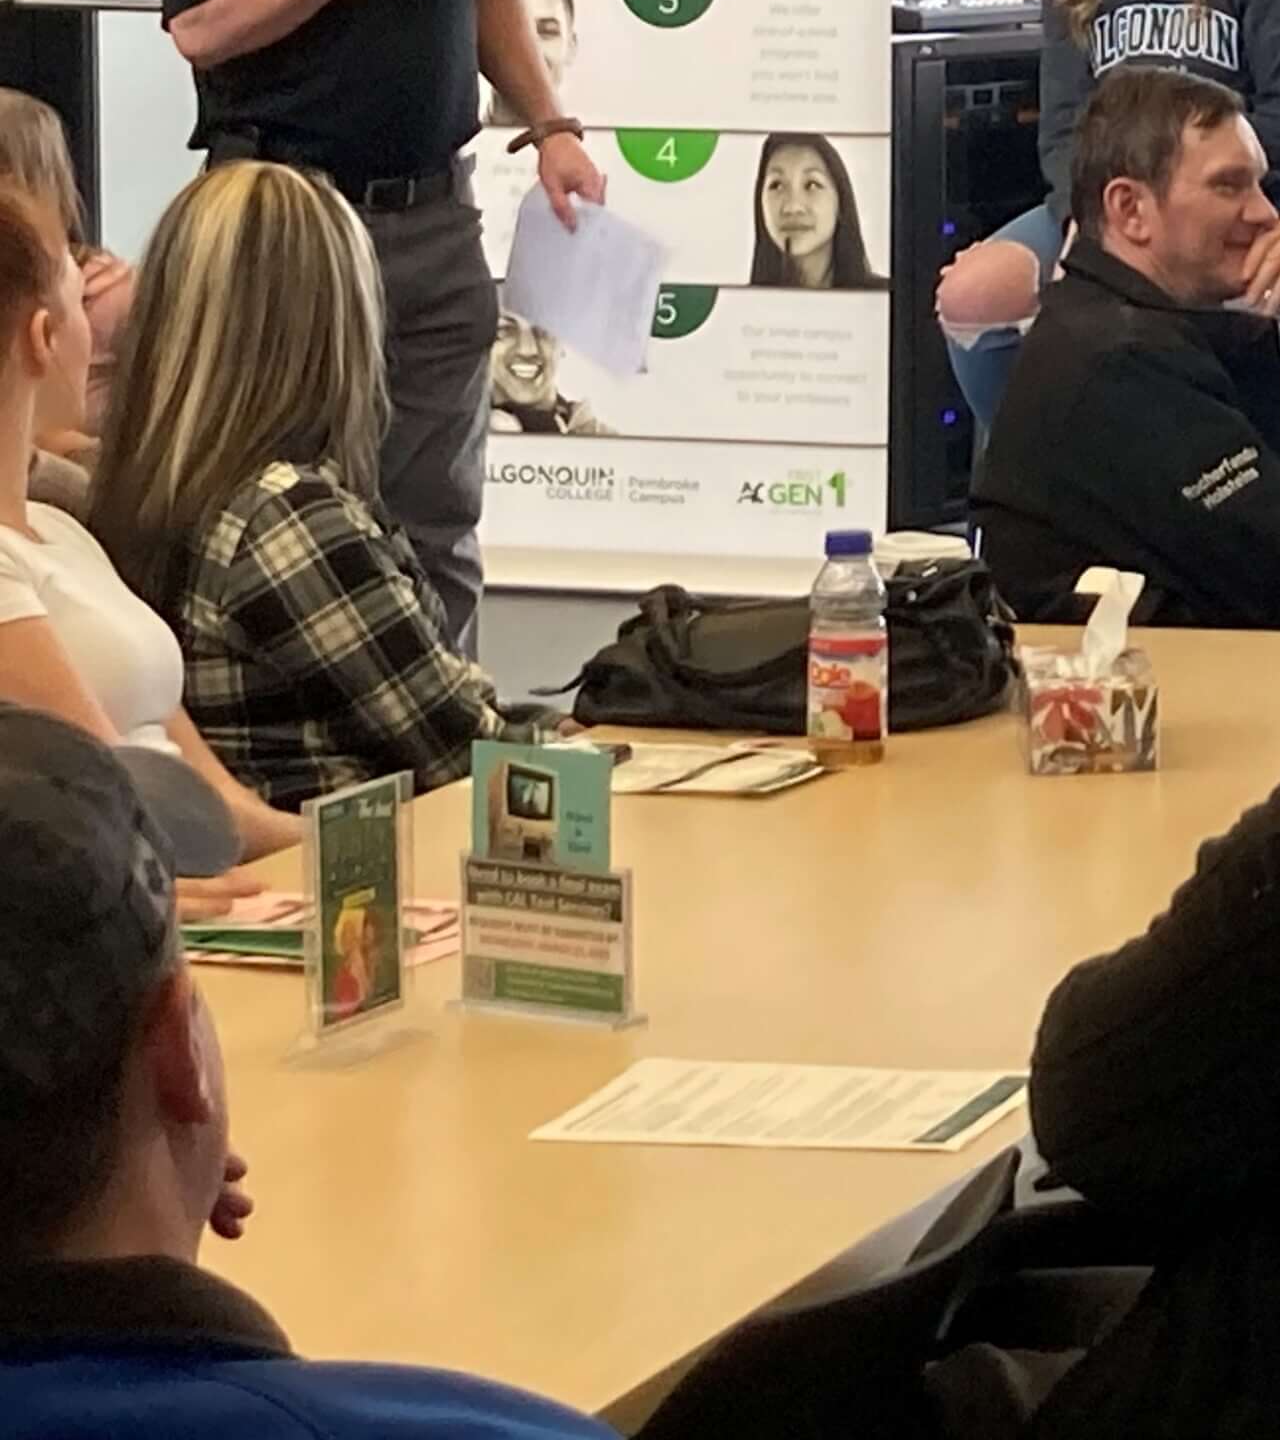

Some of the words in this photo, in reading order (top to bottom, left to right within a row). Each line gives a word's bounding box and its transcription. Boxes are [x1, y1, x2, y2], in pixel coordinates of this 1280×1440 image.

[1093, 2, 1240, 79] LGONQUIN
[655, 137, 678, 168] 4
[656, 292, 677, 325] 5
[488, 464, 615, 486] LGONQUIN
[628, 476, 700, 491] Pembroke
[545, 486, 613, 502] COLLEGE
[628, 492, 685, 505] Campus
[768, 482, 823, 507] GEN
[828, 471, 846, 508] 1
